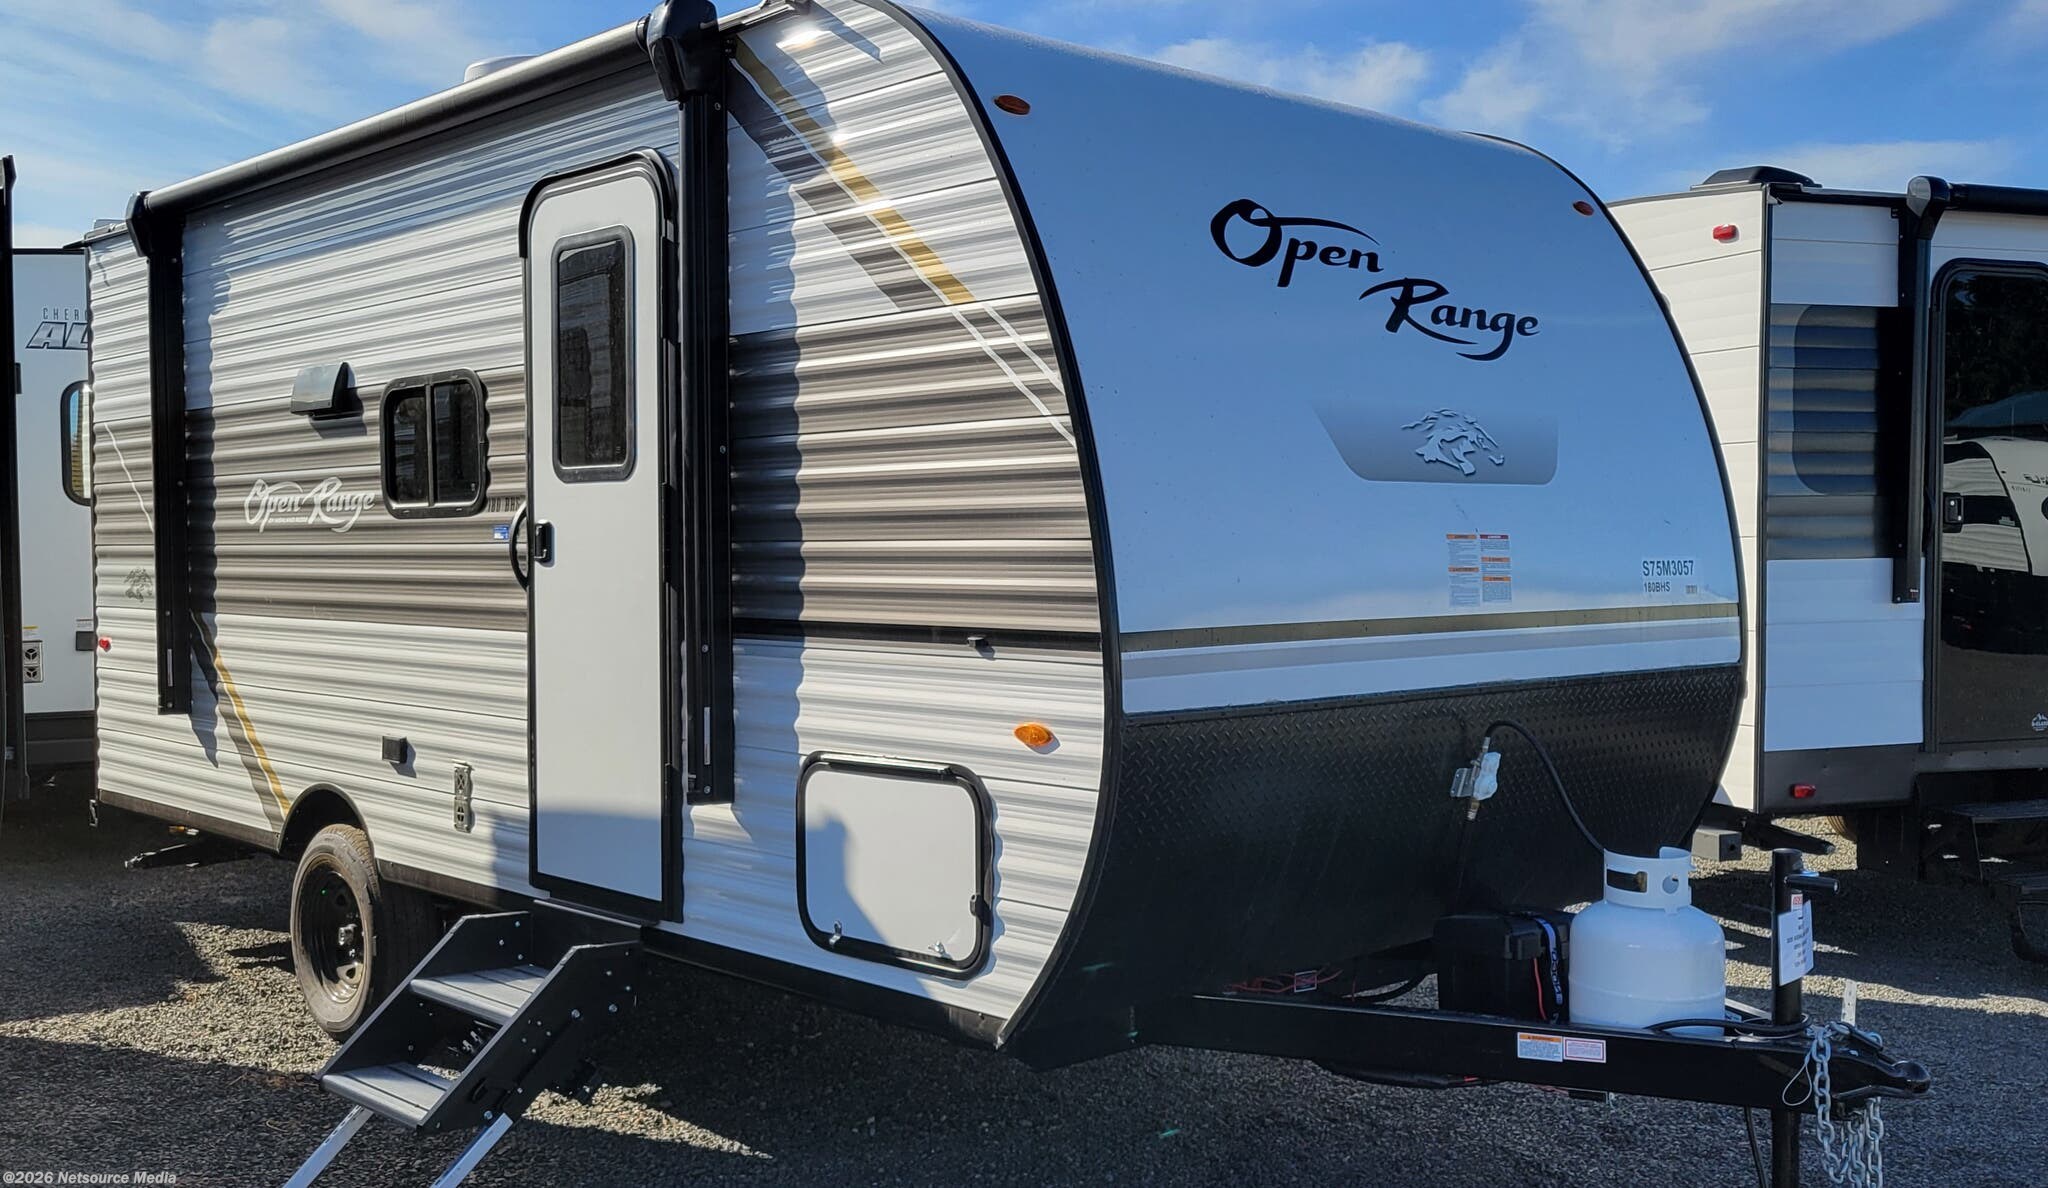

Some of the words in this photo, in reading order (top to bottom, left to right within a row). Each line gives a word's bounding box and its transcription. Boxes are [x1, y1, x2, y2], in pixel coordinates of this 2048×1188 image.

[1210, 199, 1385, 288] Open
[43, 306, 88, 321] CHER
[1358, 277, 1541, 362] Range
[244, 478, 304, 533] Open
[301, 476, 376, 533] Range
[1642, 559, 1694, 577] S75M3057
